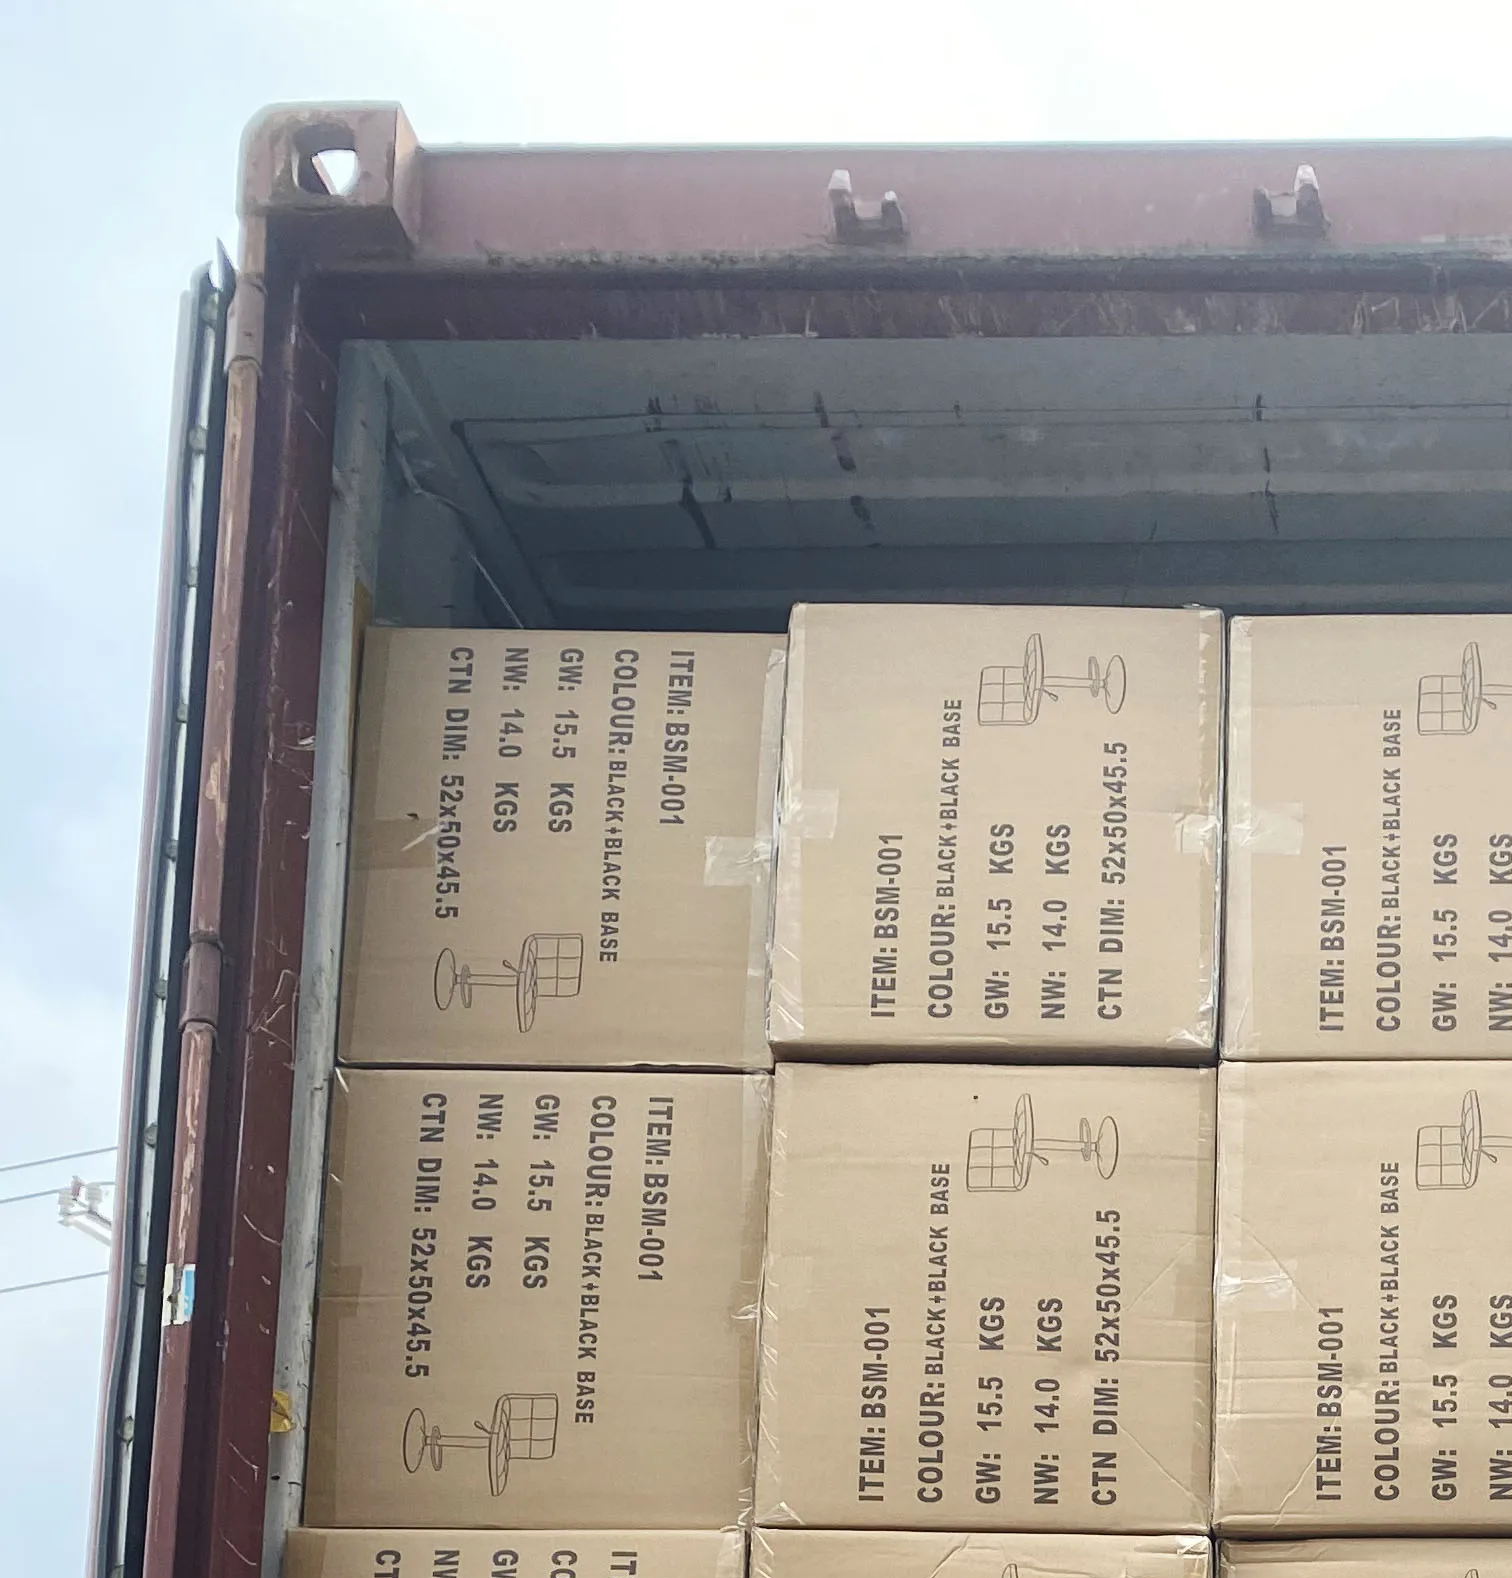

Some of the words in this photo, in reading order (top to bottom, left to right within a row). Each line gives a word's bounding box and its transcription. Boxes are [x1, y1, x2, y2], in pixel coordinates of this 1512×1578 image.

[447, 646, 474, 694] CTN
[556, 647, 584, 691] GW:
[441, 708, 469, 761] DIM:
[551, 709, 579, 759] 15.5
[547, 782, 574, 833] KGS
[1101, 741, 1128, 885] 52x50x45.5
[434, 774, 464, 919] 52x50x45.5
[1044, 823, 1071, 875] KGS
[1432, 832, 1458, 884] KGS
[1041, 898, 1068, 951] 14.0
[1098, 898, 1125, 953] DIM:
[1432, 908, 1458, 961] 15.5
[1040, 970, 1067, 1019] NW:
[1097, 968, 1123, 1019] CTN
[1431, 982, 1457, 1031] GW:
[418, 1093, 447, 1143] CTN
[475, 1093, 504, 1140] NW:
[412, 1157, 442, 1213] DIM:
[470, 1158, 499, 1210] 14.0
[929, 1162, 950, 1215] BASE
[464, 1235, 493, 1288] KGS
[1094, 1209, 1121, 1362] 52x50x45.5
[404, 1227, 436, 1378] 52x50x45.5
[978, 1296, 1005, 1350] KGS
[976, 1376, 1004, 1431] 15.5
[1092, 1377, 1119, 1434] DIM:
[974, 1452, 1001, 1503] GW:
[1091, 1451, 1117, 1505] CTN
